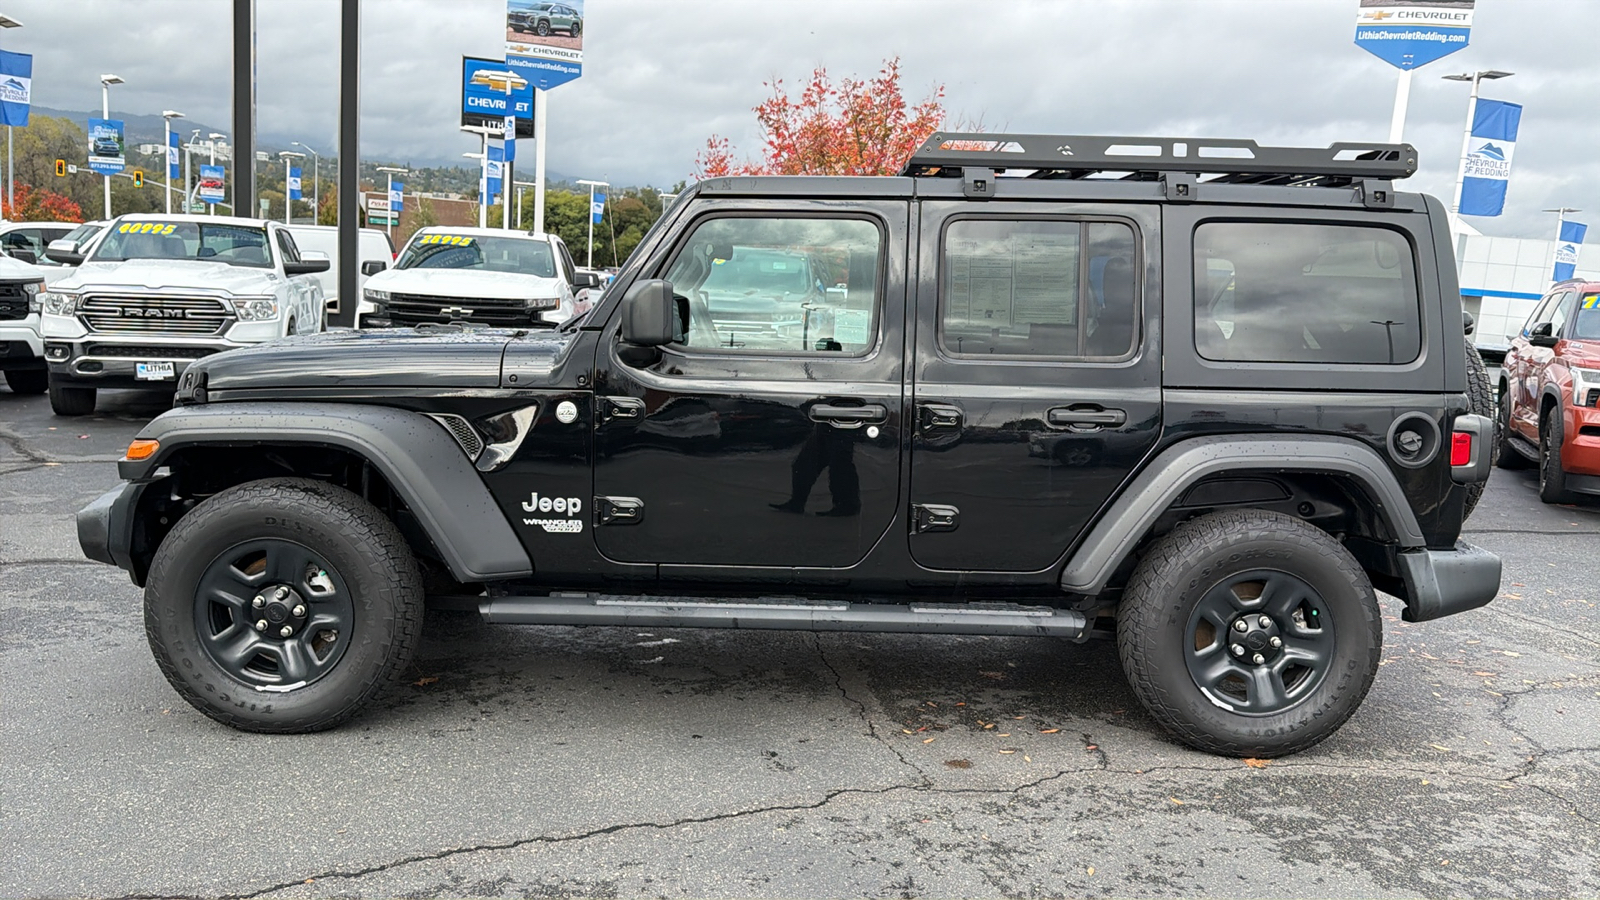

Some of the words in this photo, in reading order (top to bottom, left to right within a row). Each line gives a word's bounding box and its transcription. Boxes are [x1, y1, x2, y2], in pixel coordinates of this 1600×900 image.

[1398, 11, 1469, 20] CHEVROLET
[1358, 30, 1466, 43] LithiaChevroletRedding.com
[533, 47, 580, 59] CHEVROLET
[507, 58, 580, 74] LithiaChevroletRedding.com
[468, 97, 529, 112] CHEVRET
[1475, 167, 1509, 177] REDDING
[119, 222, 177, 235] 40995
[420, 235, 473, 246] 28995
[124, 308, 183, 317] RAM
[146, 364, 172, 372] LITHIA
[522, 492, 582, 516] Jeep
